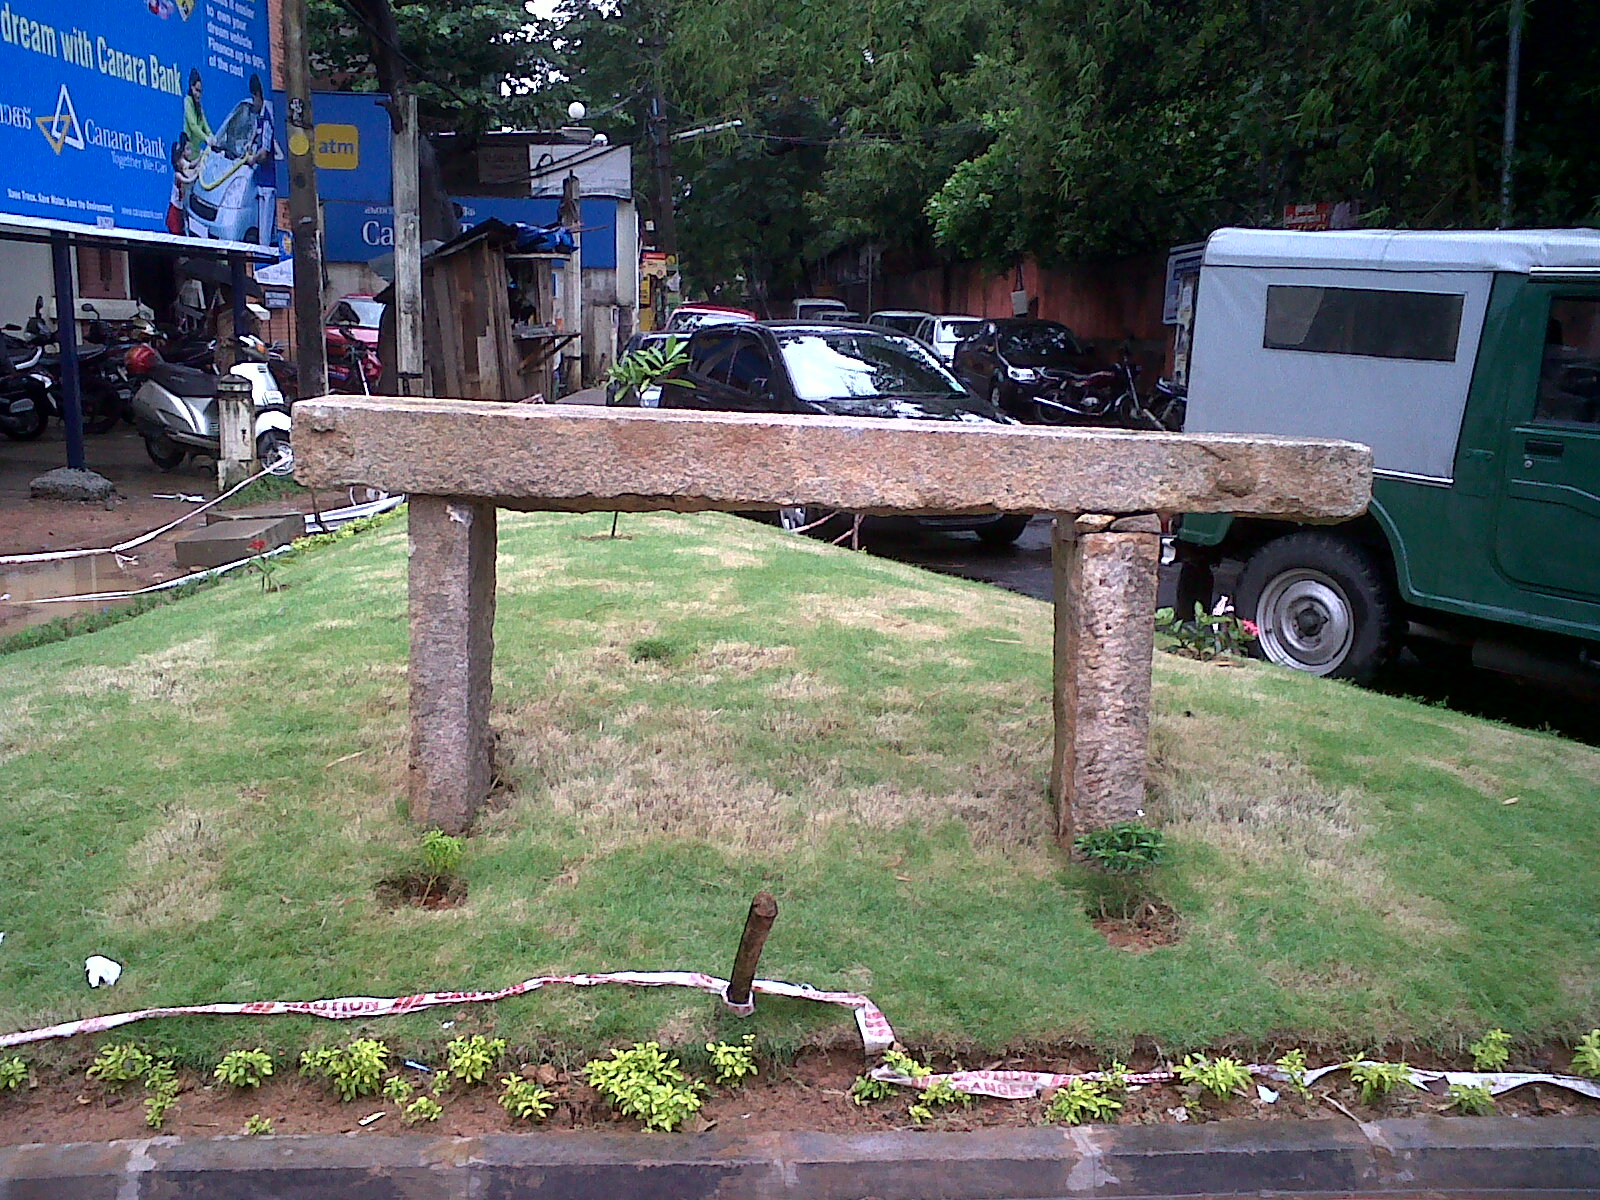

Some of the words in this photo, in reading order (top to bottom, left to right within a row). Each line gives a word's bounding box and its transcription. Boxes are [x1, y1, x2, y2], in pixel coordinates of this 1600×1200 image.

[0, 2, 57, 58] dream
[60, 26, 94, 70] with
[96, 36, 148, 87] Canara
[149, 54, 182, 97] Bank
[85, 119, 133, 153] Canara
[135, 130, 167, 160] Bank
[318, 138, 355, 154] atm
